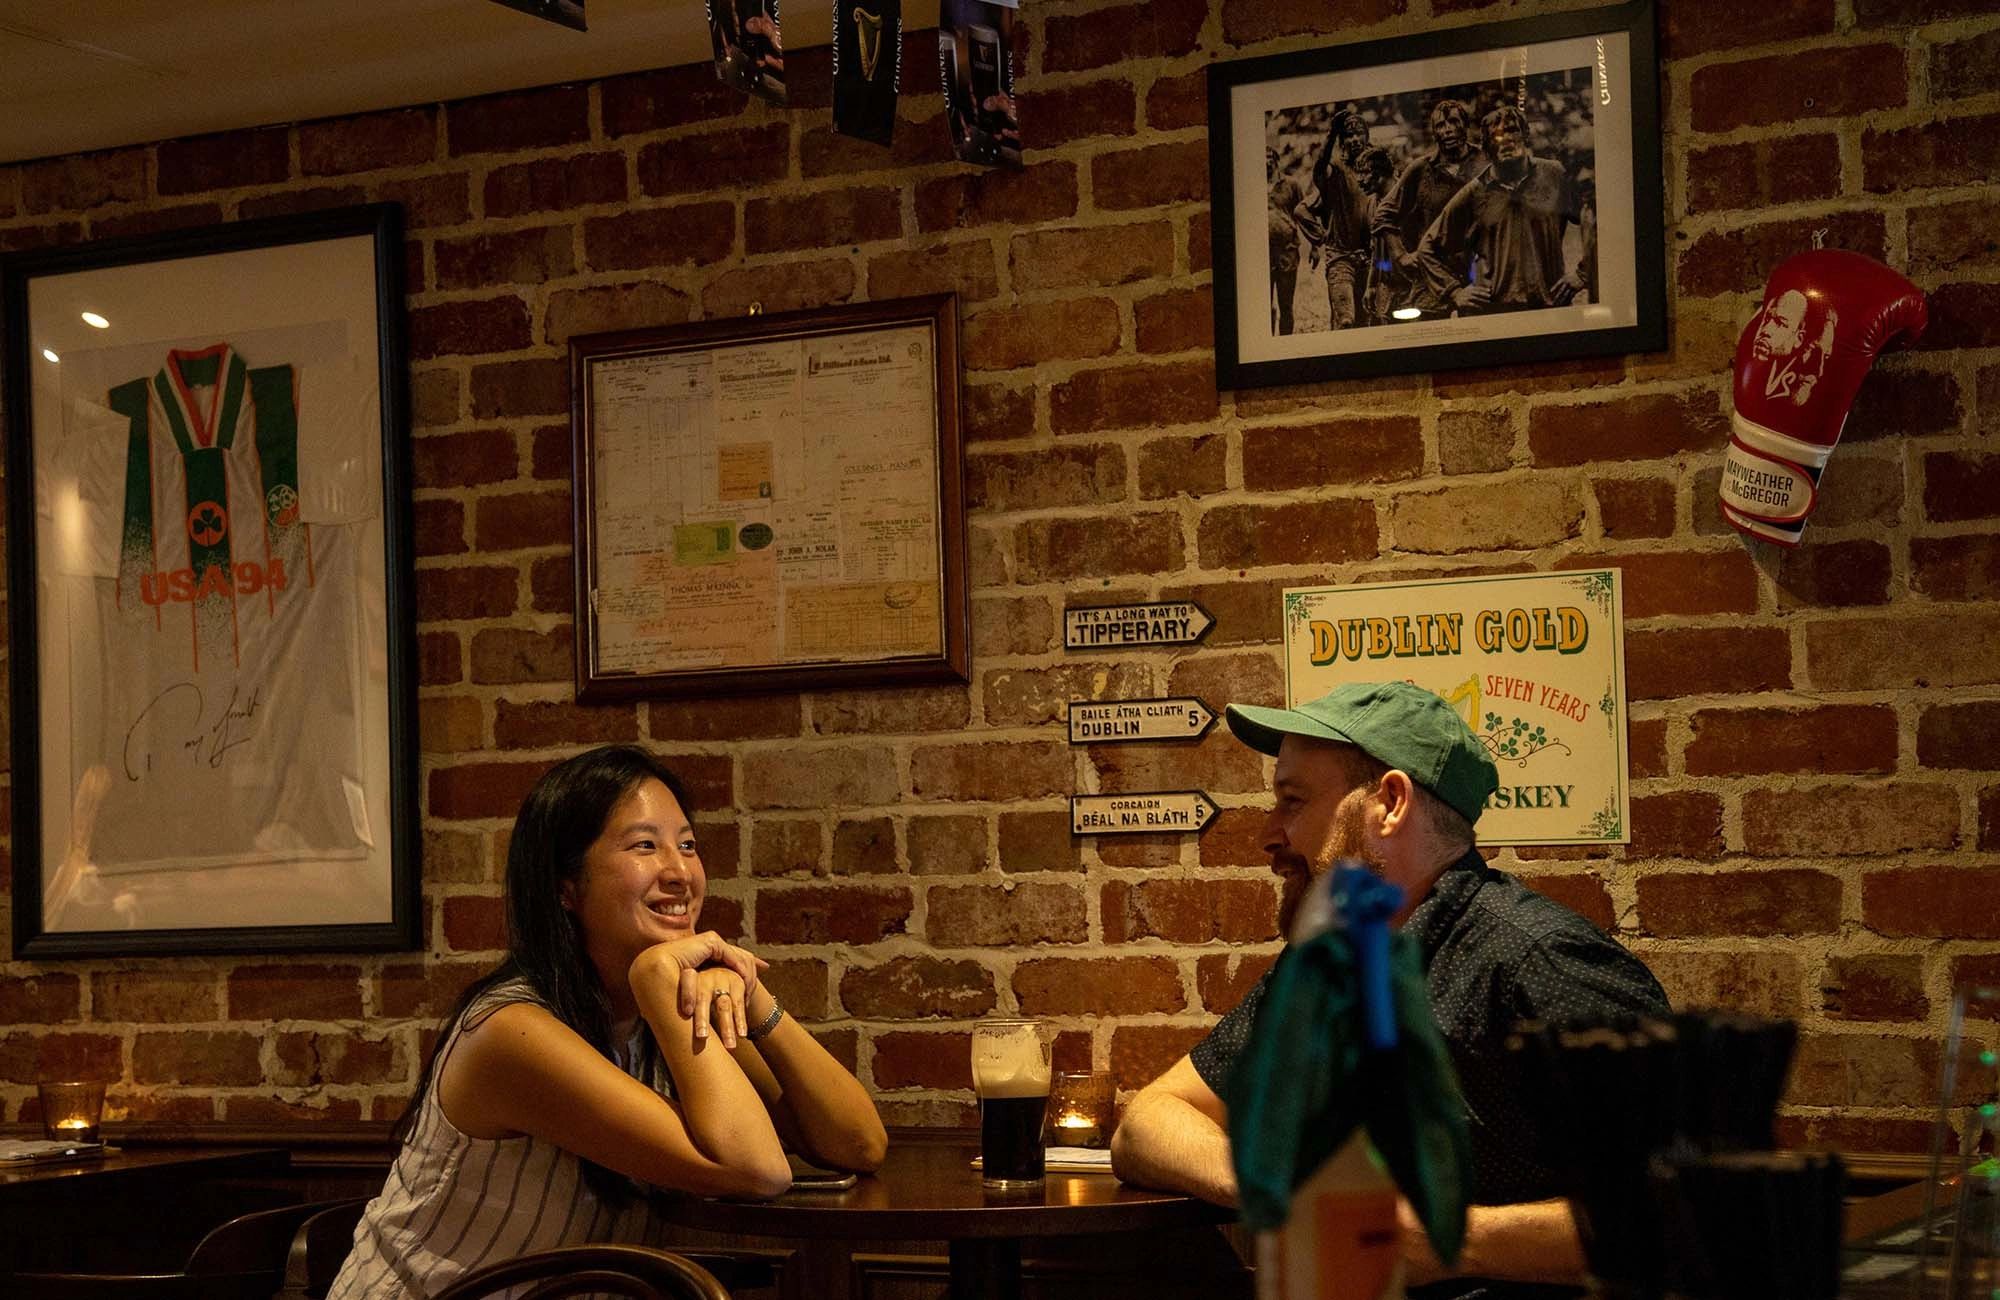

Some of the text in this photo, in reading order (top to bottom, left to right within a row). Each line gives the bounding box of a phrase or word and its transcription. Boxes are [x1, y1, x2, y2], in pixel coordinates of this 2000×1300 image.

[893, 17, 903, 94] GUINNESS
[1727, 459, 1793, 492] MAYWEATHER
[1731, 480, 1789, 507] McGREGOR
[1078, 606, 1188, 622] IT'S A LONG WAY TO
[1075, 618, 1190, 643] TIPPERARY
[1309, 607, 1589, 666] DUBLIN GOLD
[1485, 675, 1590, 723] SEVEN YEARS
[1081, 705, 1184, 720] BAILE ÁTHA CLIATH
[1188, 710, 1199, 727] 5
[1081, 720, 1141, 736] DUBLIN
[1082, 809, 1189, 826] BÉAL NA BLÁTH
[1195, 804, 1204, 818] 5
